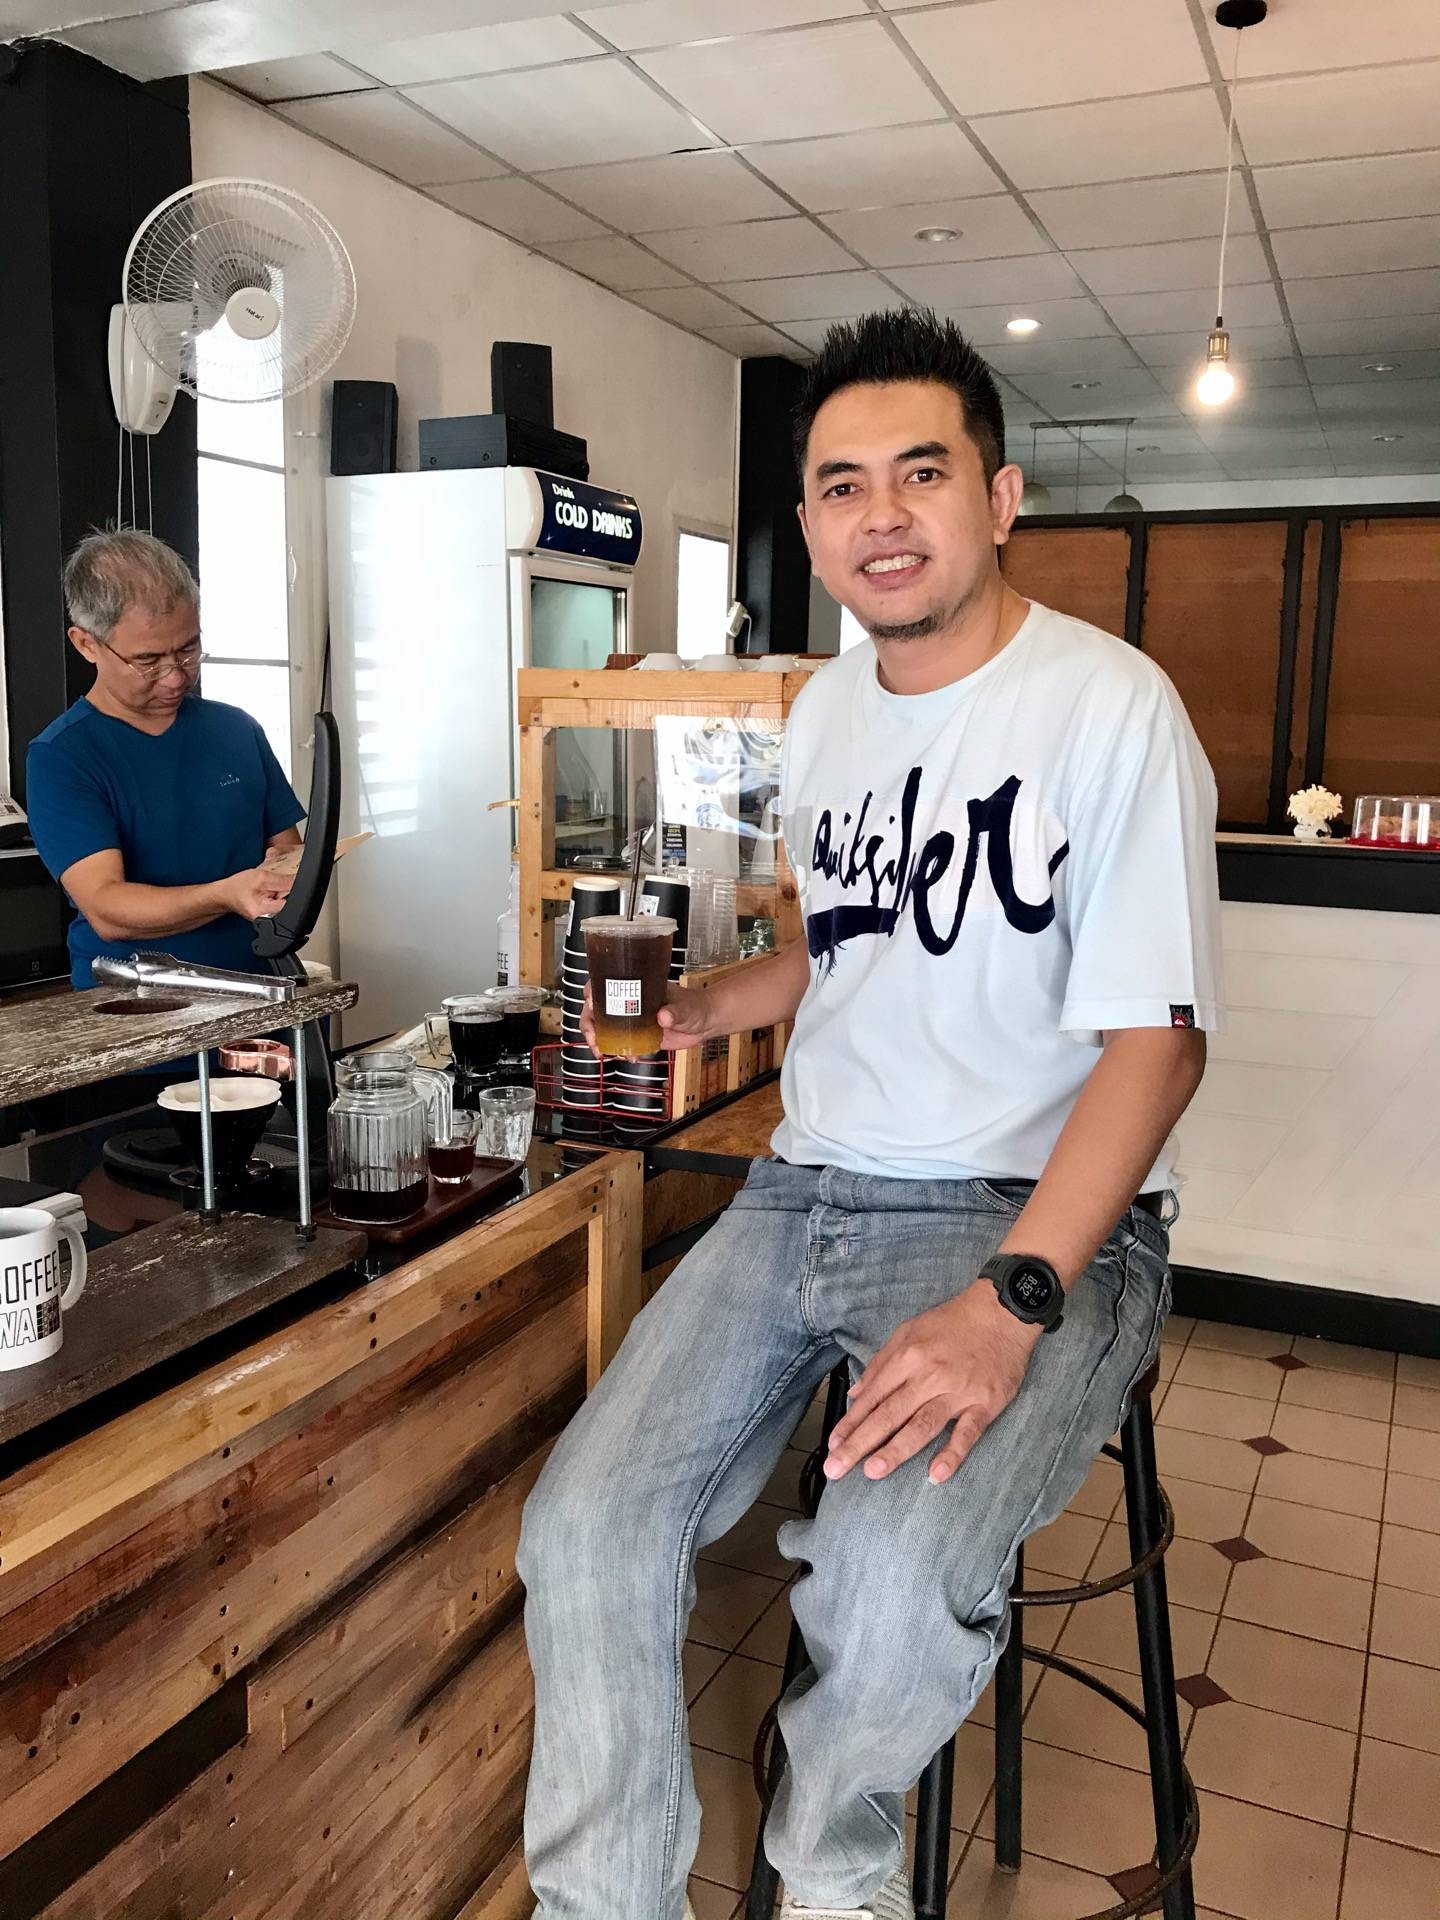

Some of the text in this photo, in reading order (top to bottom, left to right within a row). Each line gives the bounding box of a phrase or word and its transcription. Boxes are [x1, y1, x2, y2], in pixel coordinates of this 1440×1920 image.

[552, 483, 575, 499] Drink
[555, 501, 633, 539] COLD DRINKS
[608, 981, 640, 997] COFFEE
[0, 1250, 58, 1304] OFFEE
